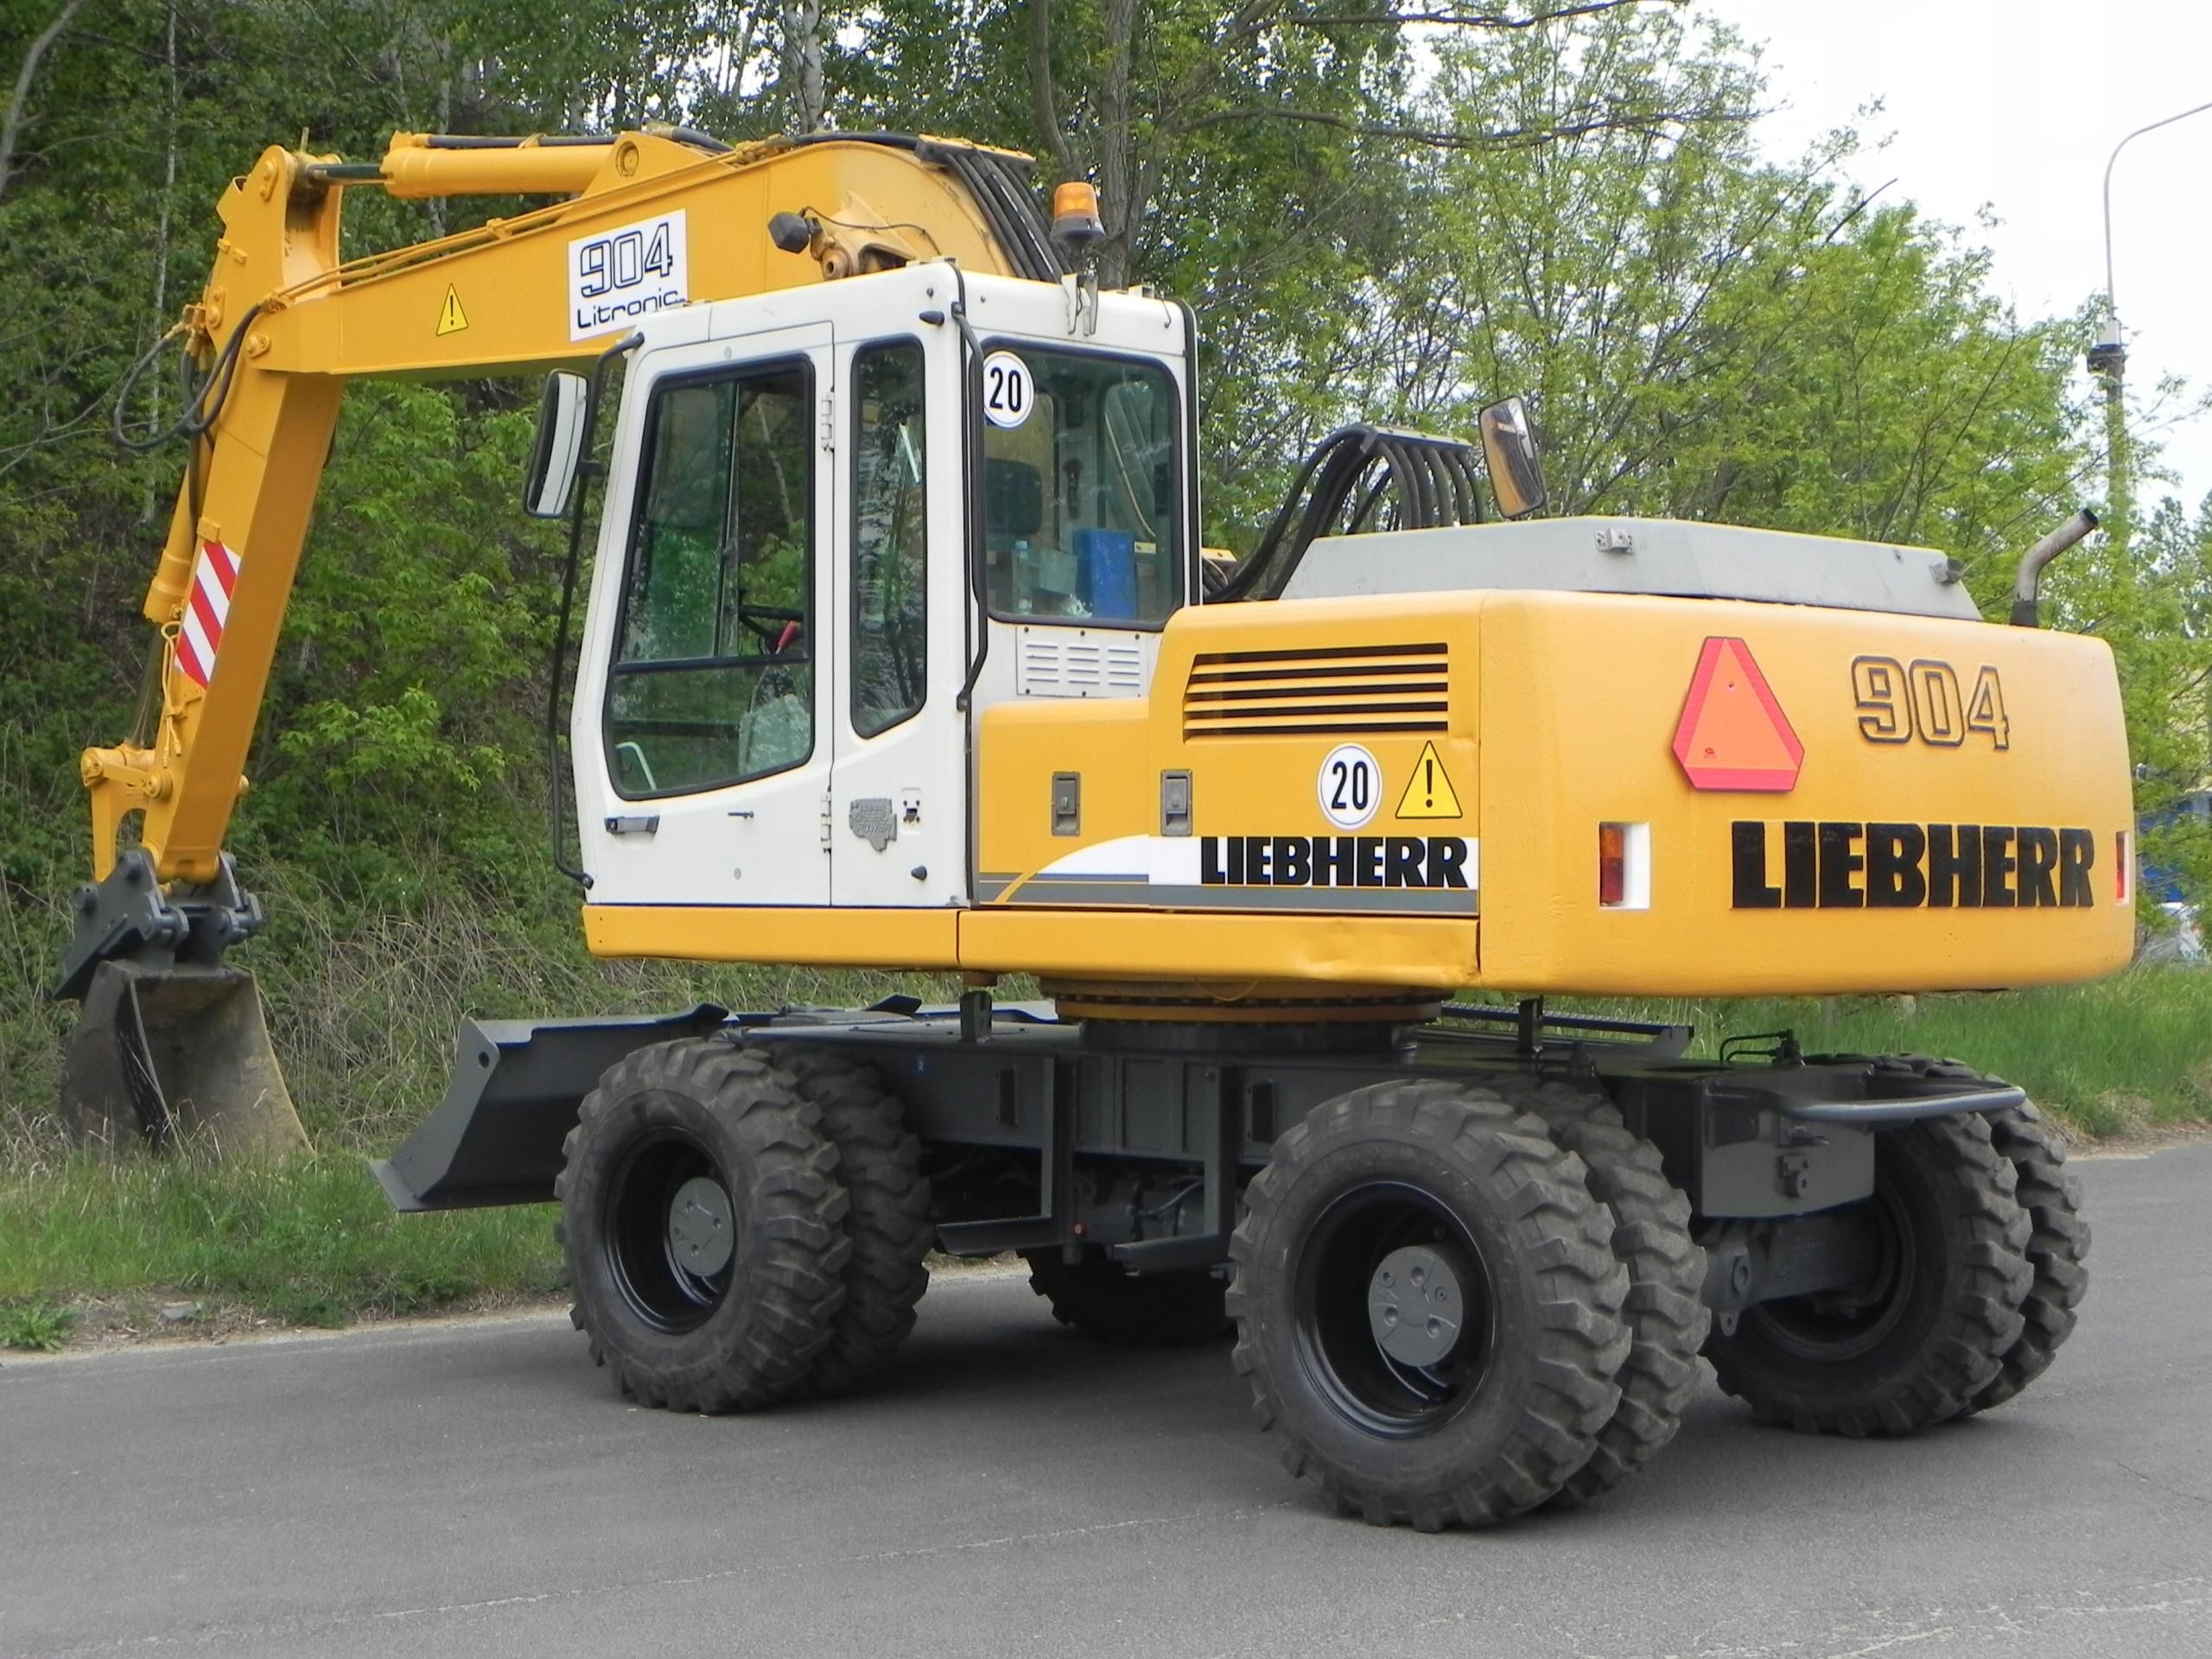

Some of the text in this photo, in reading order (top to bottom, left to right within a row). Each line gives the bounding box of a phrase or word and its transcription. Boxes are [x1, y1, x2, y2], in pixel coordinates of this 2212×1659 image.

[581, 222, 673, 298] 904
[577, 287, 680, 328] Litronic
[989, 366, 1021, 412] 20
[1851, 655, 2010, 750] 904
[1331, 760, 1369, 810] 20
[1200, 836, 1468, 888] LIEBHERR
[1732, 821, 2094, 908] LIEBHERR
